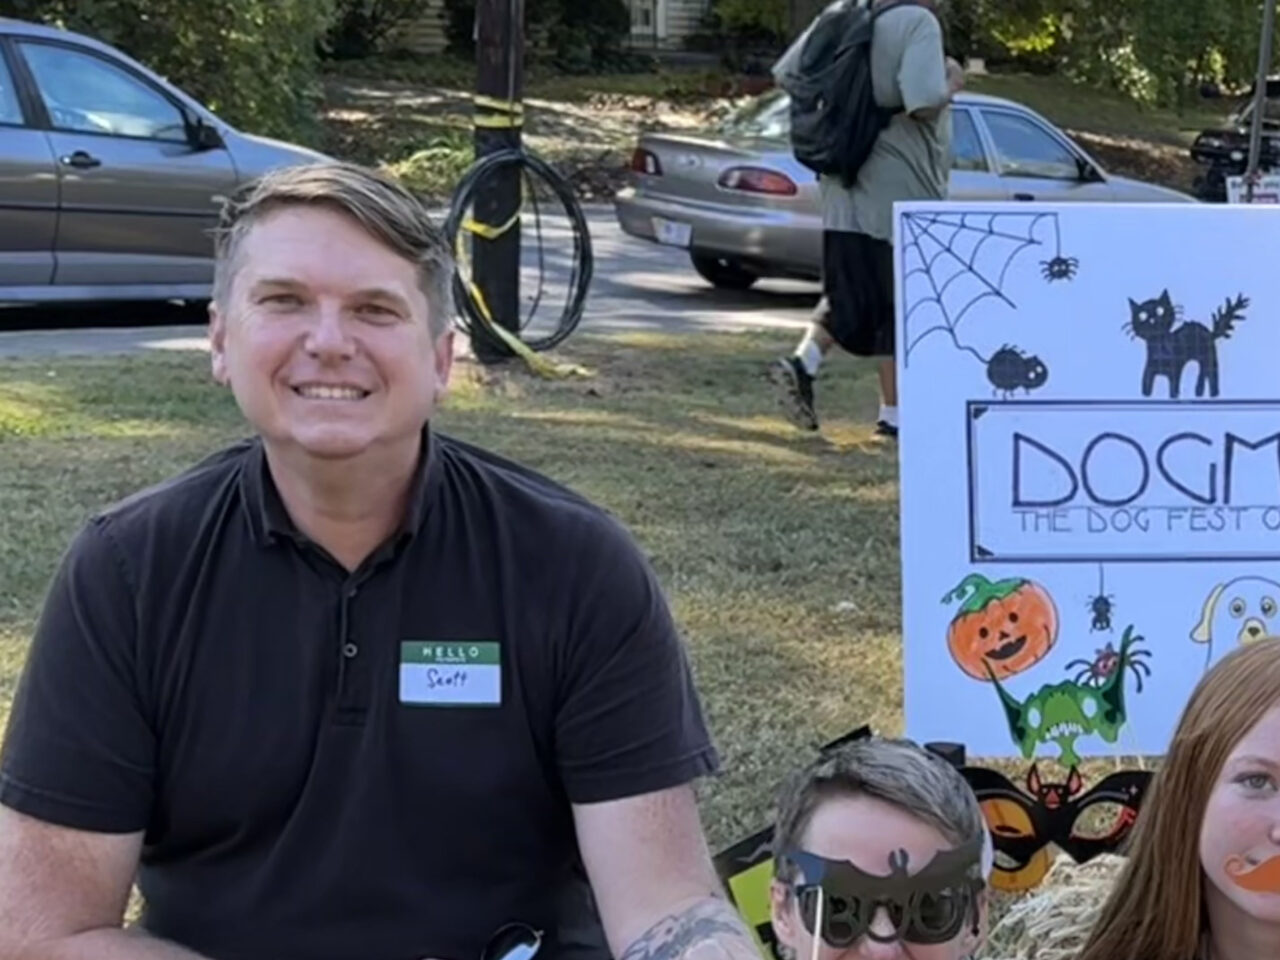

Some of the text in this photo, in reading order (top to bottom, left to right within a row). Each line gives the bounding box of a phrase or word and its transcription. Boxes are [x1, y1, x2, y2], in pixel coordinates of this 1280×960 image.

[1012, 508, 1072, 532] THE
[1087, 507, 1149, 532] DOG
[1167, 507, 1248, 531] FEST
[422, 646, 479, 657] HELLO
